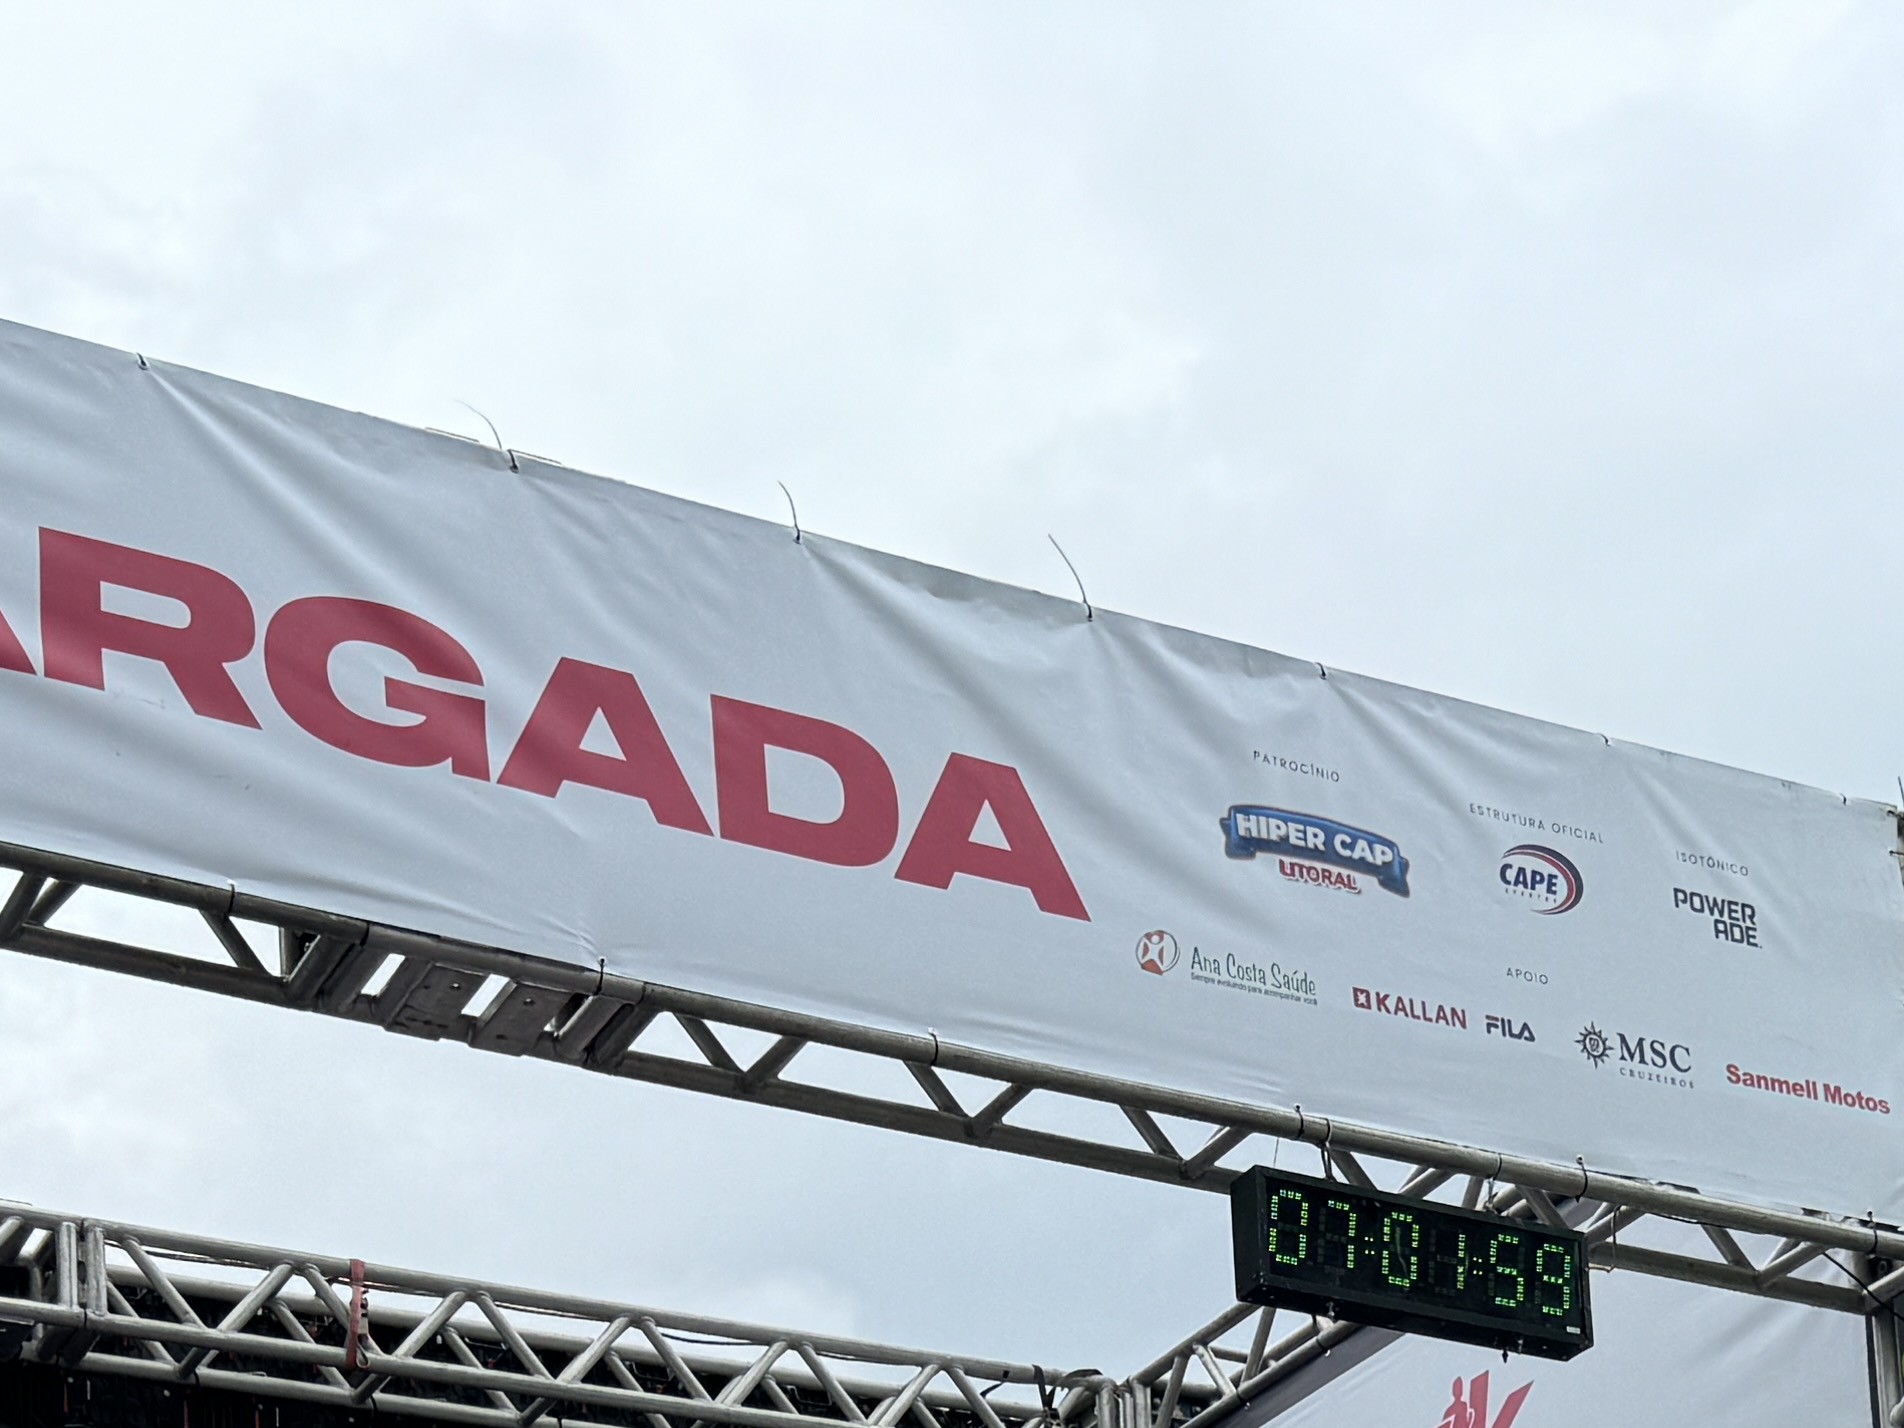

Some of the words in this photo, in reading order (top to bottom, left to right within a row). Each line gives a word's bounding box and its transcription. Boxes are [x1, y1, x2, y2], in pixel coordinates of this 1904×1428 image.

[1253, 750, 1340, 783] PATROCÍNIO
[1236, 813, 1325, 851] HIPER
[1333, 833, 1394, 866] CAP
[1469, 803, 1546, 831] ESTRUTURA
[1551, 822, 1604, 845] OFICIAL
[1279, 858, 1360, 892] LITORAL
[1499, 862, 1559, 896] CAPE
[1675, 849, 1749, 877] ISOTÔNICO
[1673, 887, 1757, 926] POWER
[1191, 946, 1222, 977] Ana
[1226, 952, 1267, 986] Costa
[1270, 962, 1317, 997] Saúde
[1506, 967, 1549, 985] APOIO
[1375, 991, 1468, 1030] KALLAN
[1485, 1014, 1536, 1043] FILA
[1617, 1033, 1692, 1074] MSC
[1726, 1063, 1819, 1101] Sanmell
[1823, 1083, 1892, 1115] Motos
[1268, 1189, 1572, 1317] 07:01:59
